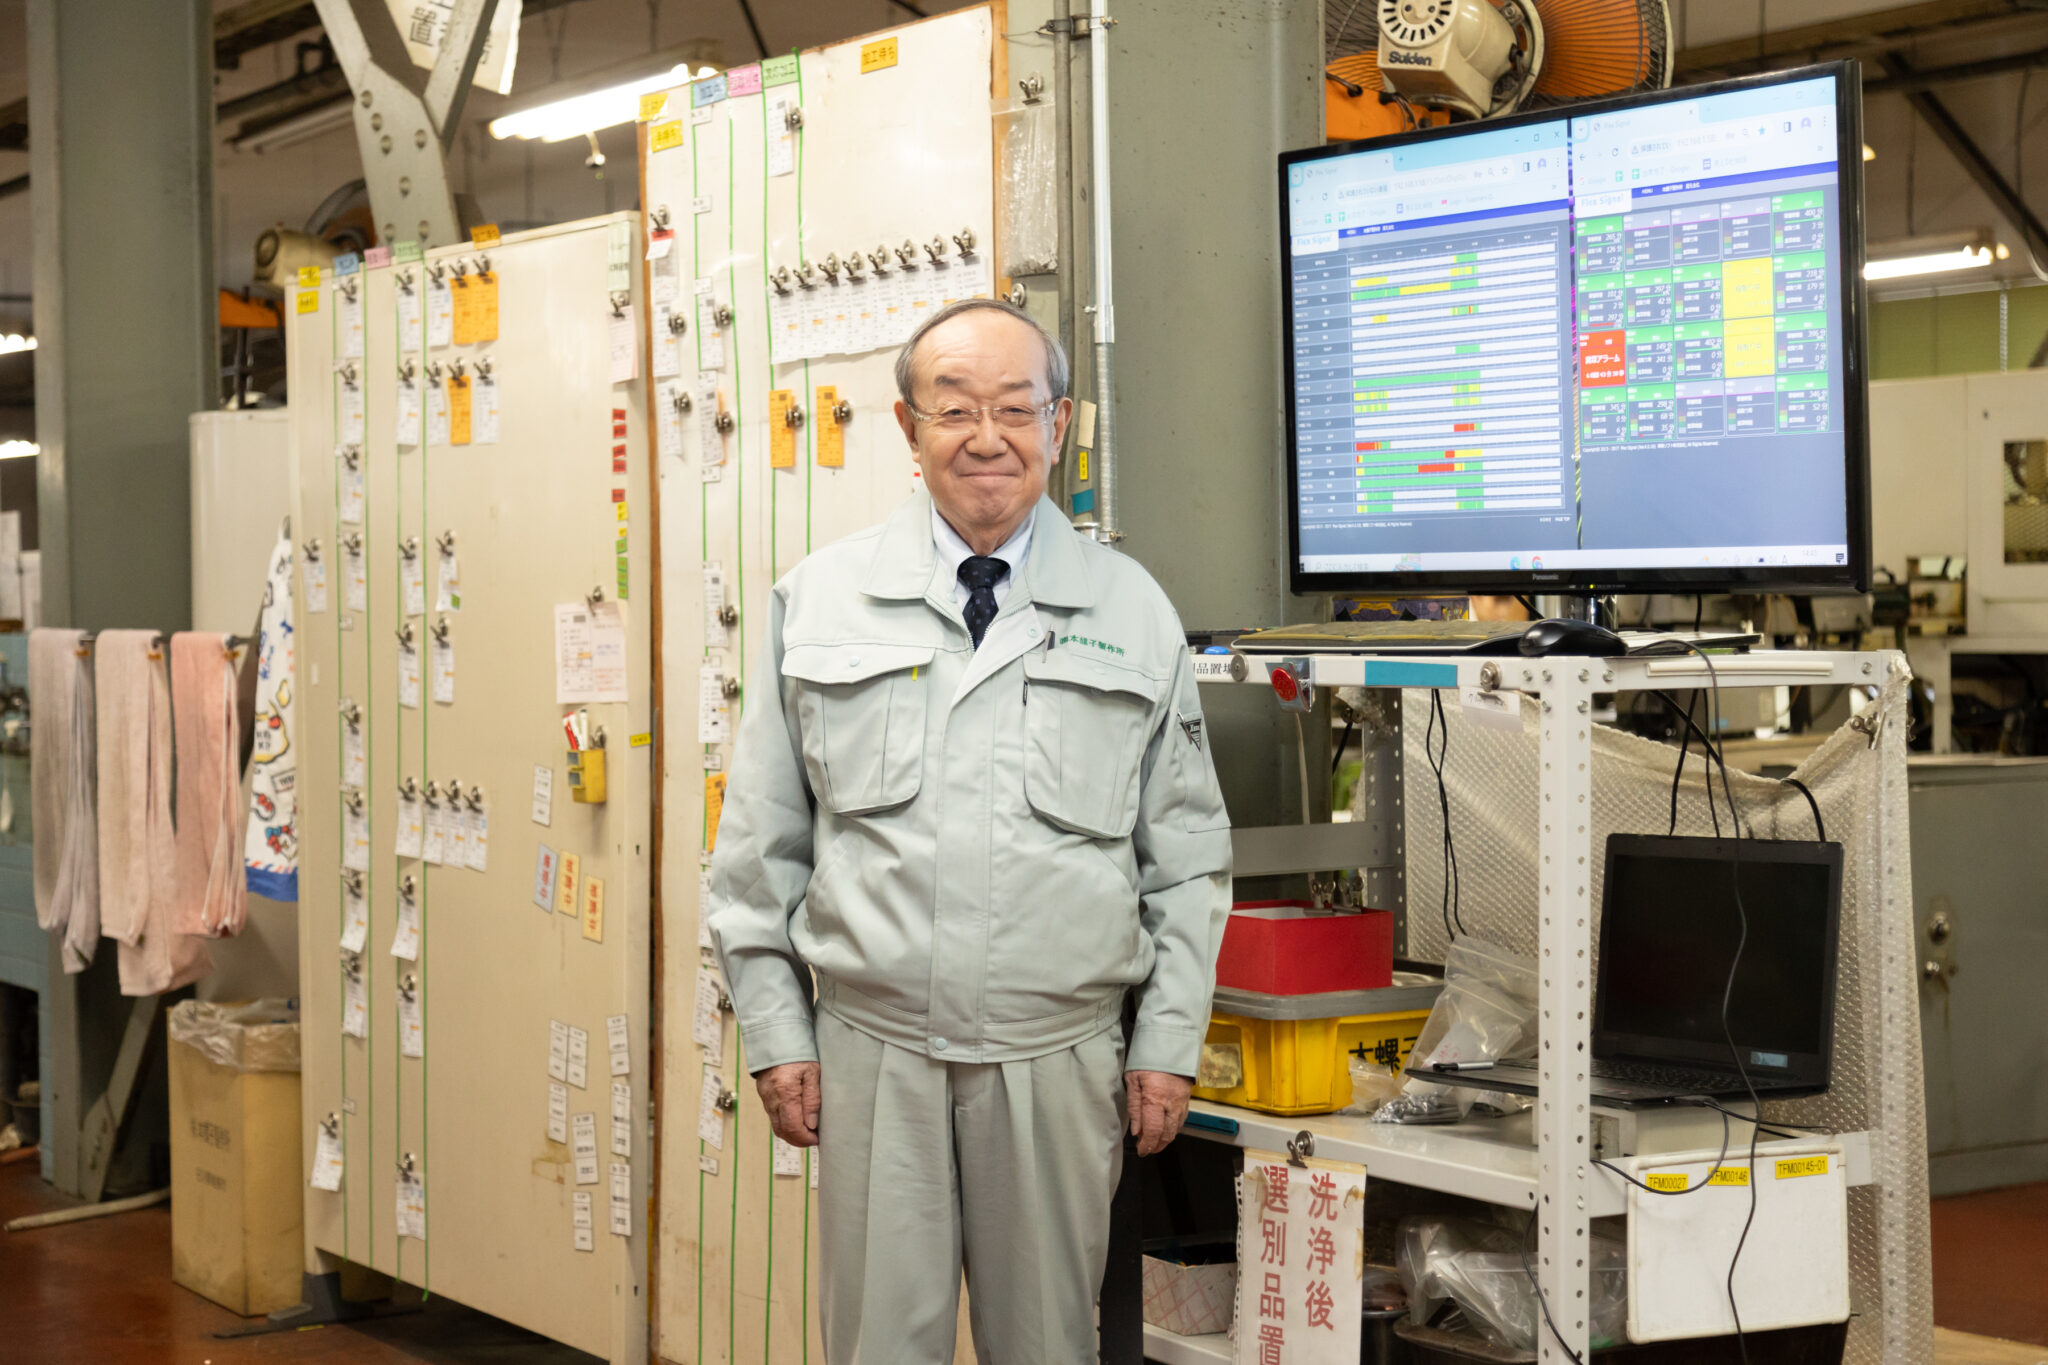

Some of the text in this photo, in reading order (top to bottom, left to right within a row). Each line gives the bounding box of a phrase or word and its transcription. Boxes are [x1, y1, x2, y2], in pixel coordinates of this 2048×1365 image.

[1194, 662, 1230, 674] 品置場
[1778, 1160, 1826, 1176] TFM00145-01
[1649, 1177, 1686, 1189] TFM00027
[1304, 1172, 1338, 1331] 洗浄後
[1258, 1166, 1289, 1365] 選別品置
